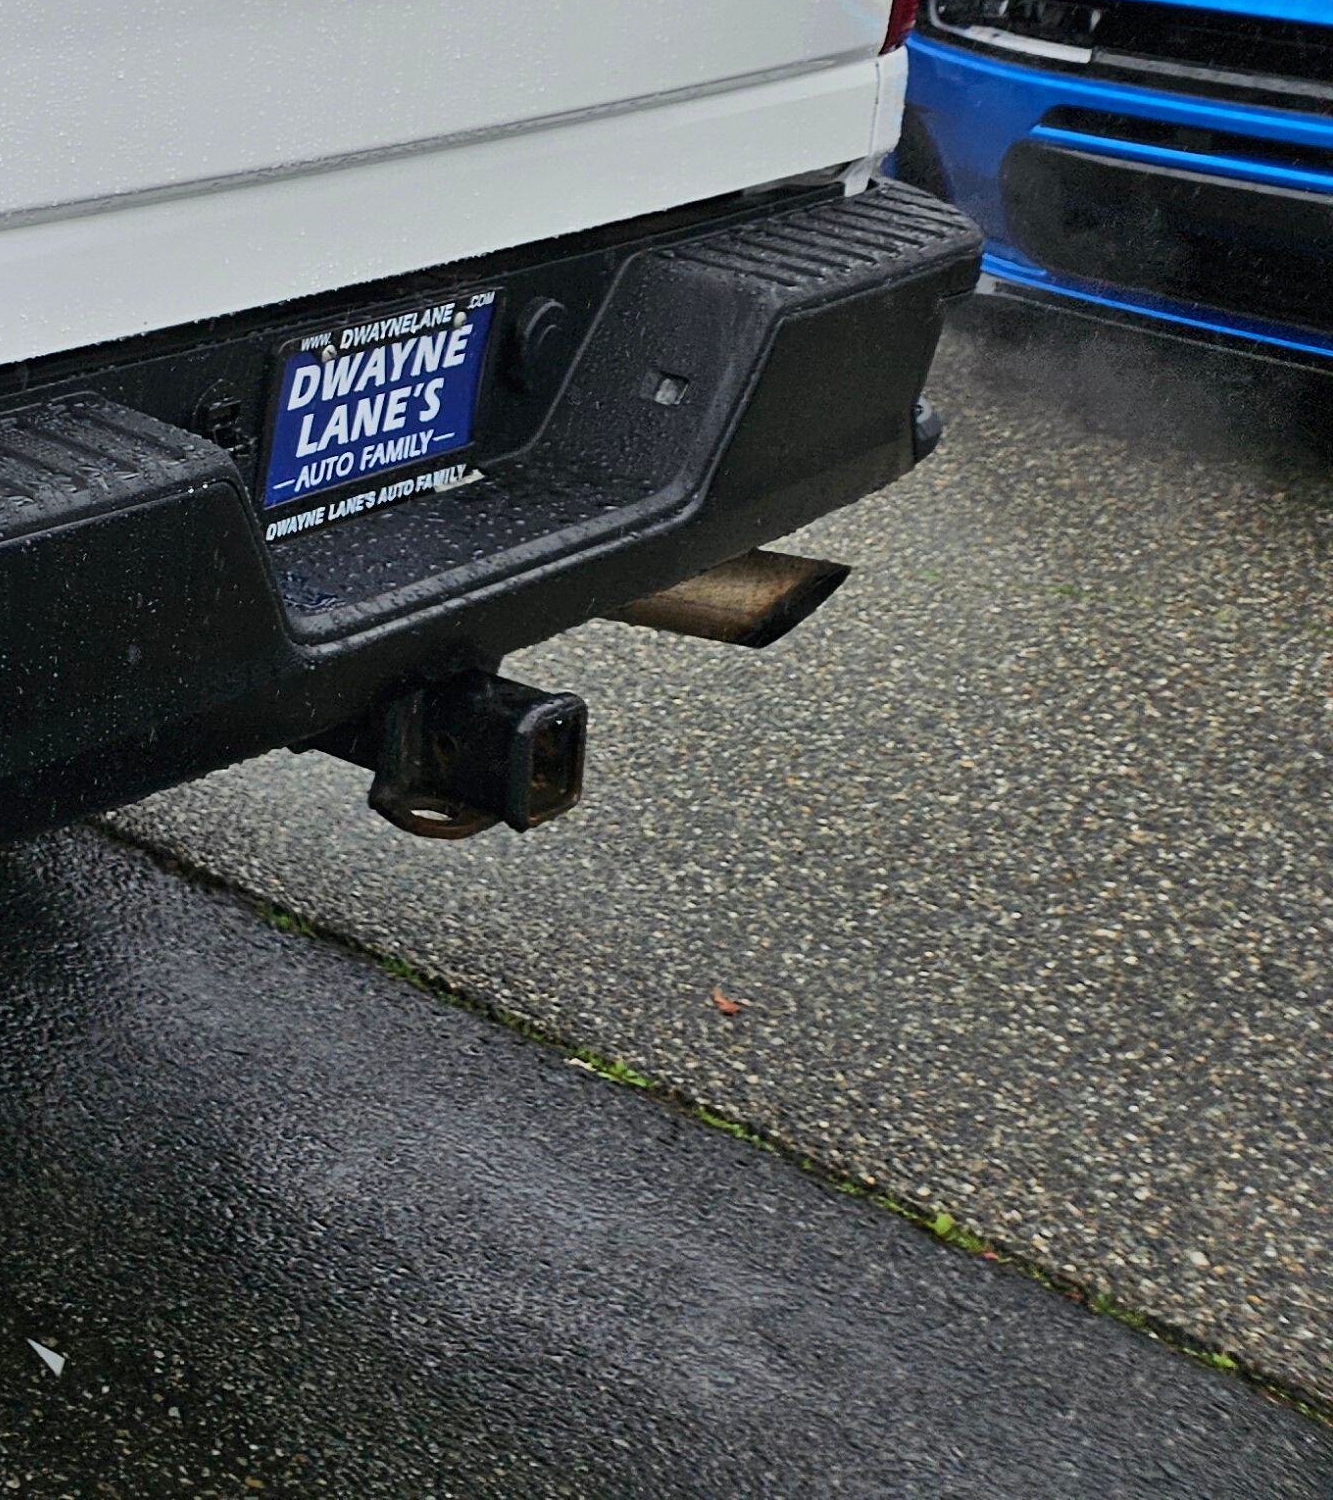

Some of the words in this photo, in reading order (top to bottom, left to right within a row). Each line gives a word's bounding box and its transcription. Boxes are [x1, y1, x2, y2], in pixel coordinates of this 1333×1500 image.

[339, 302, 455, 350] DWAYNELANE
[287, 323, 474, 412] DWAYNE
[295, 377, 445, 459] LANE'S
[294, 452, 354, 493] AUTO
[359, 428, 436, 471] FAMILY
[265, 506, 326, 541] DWAYNE
[327, 490, 376, 521] LANE'S
[377, 478, 413, 505] AUTO
[413, 463, 467, 493] FAMILY
